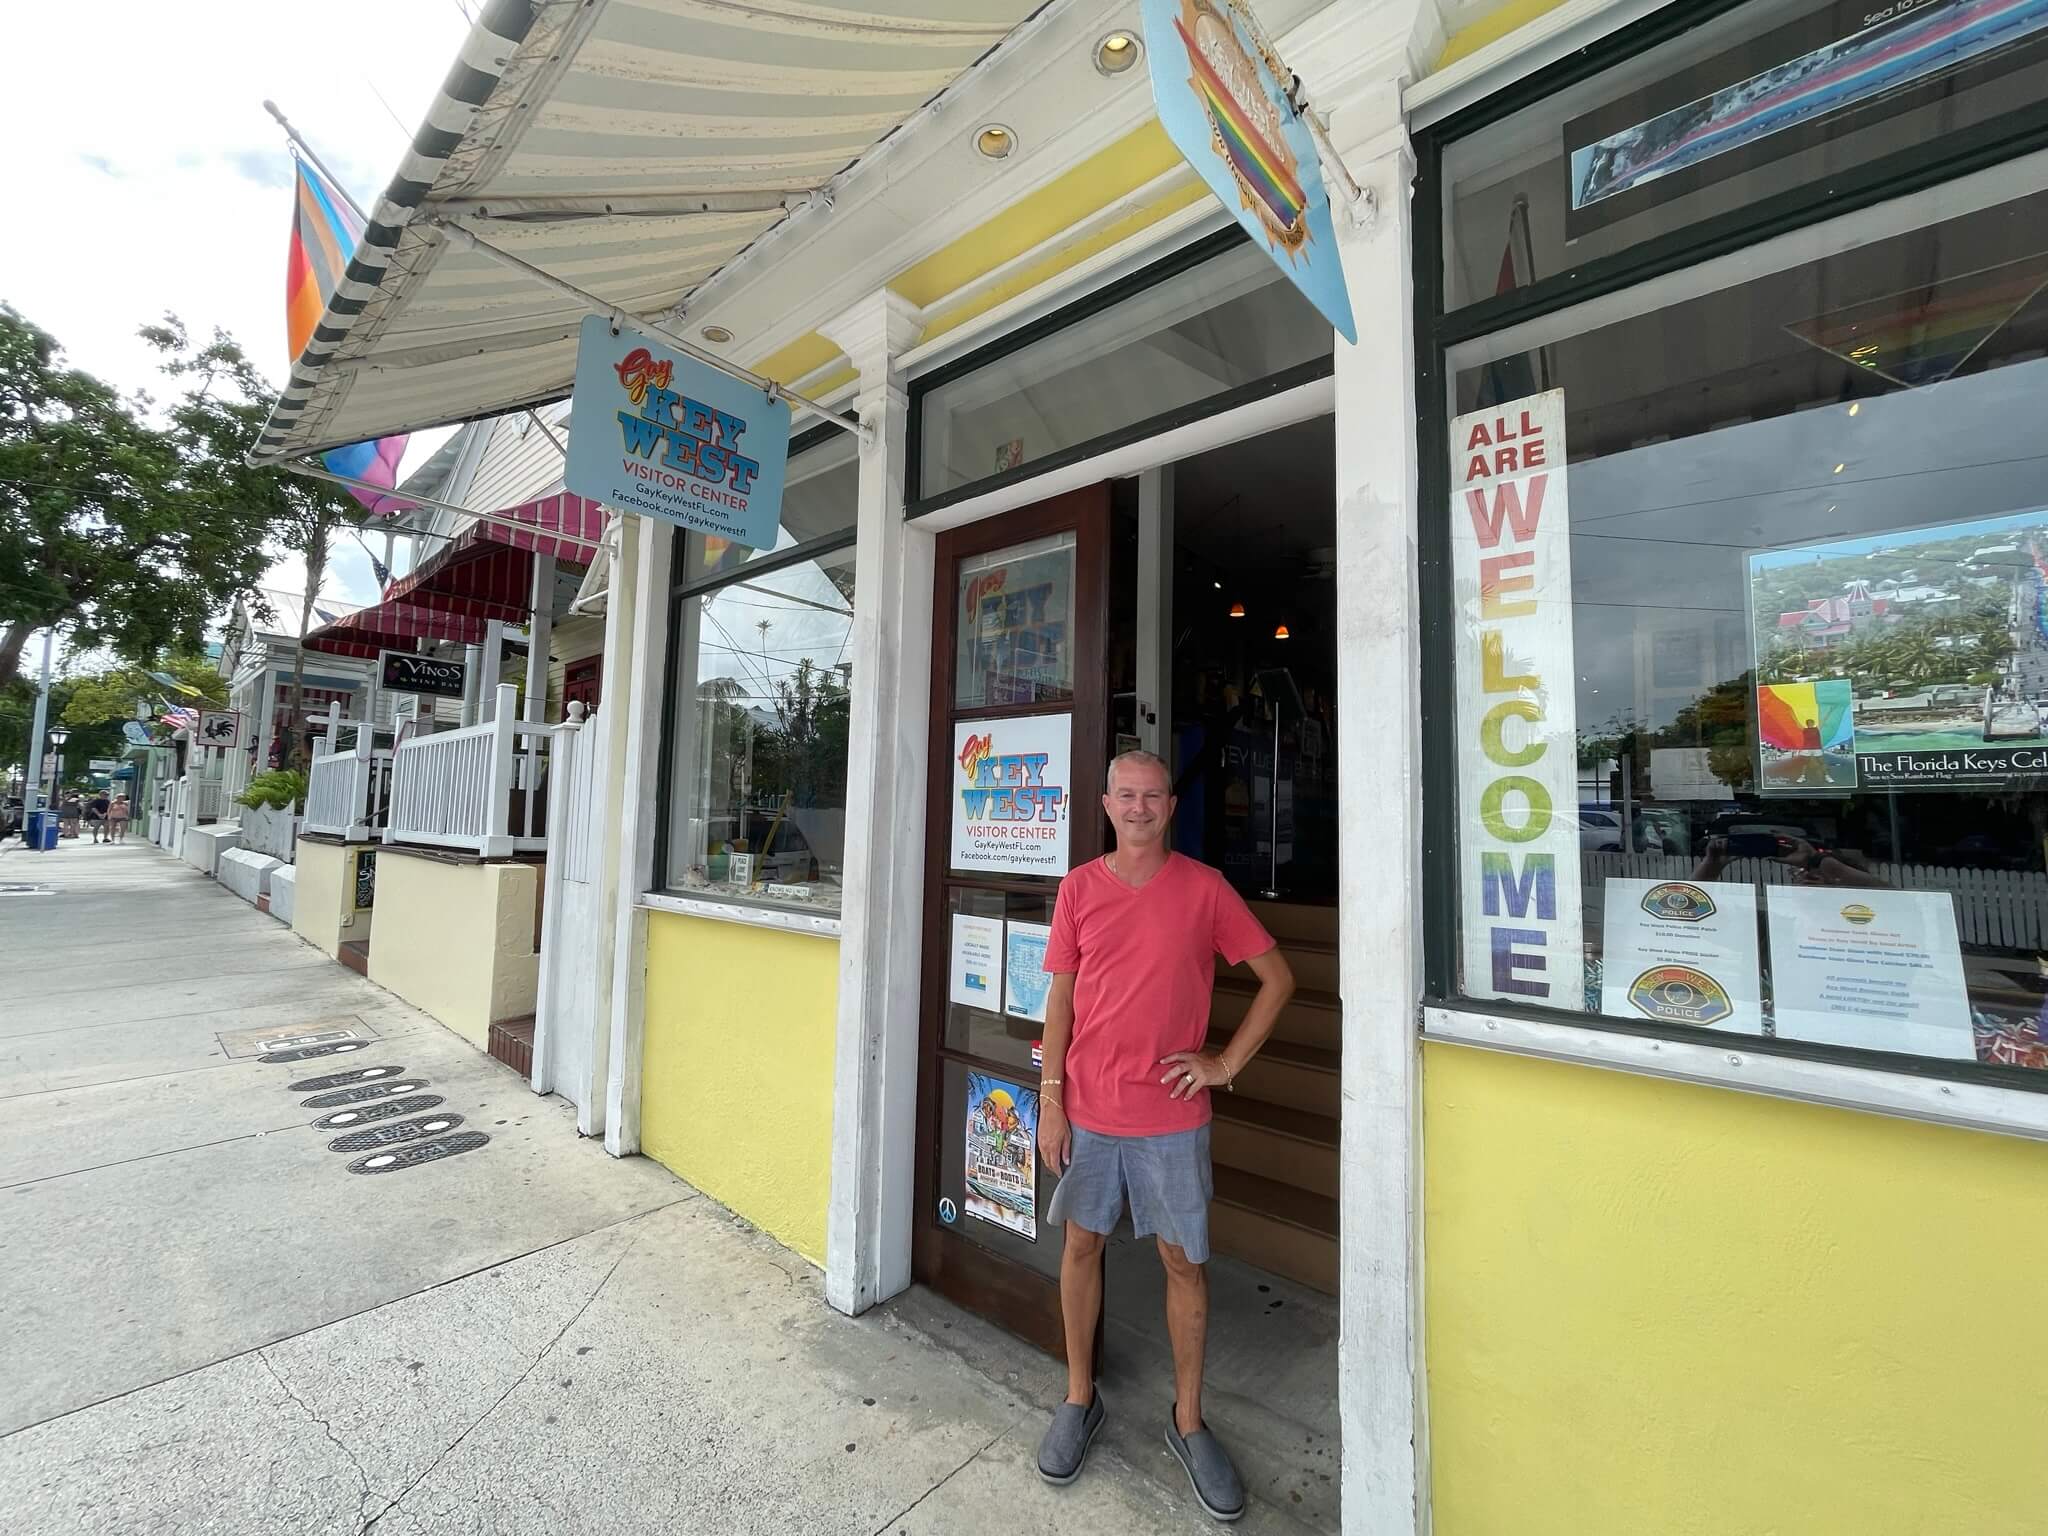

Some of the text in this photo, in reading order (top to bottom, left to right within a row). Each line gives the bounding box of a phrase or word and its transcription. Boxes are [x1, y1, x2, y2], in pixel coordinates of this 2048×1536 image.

[1863, 7, 1894, 26] Sea
[613, 347, 673, 405] Gay
[640, 384, 747, 454] KEY
[1466, 410, 1543, 450] ALL
[617, 411, 760, 496] WEST
[1466, 438, 1546, 482] ARE
[622, 459, 748, 512] VISITOR CENTER
[635, 482, 730, 520] GayKeyWestFL.com
[612, 489, 747, 537] Facebook.com/gaykeywestfl
[1465, 473, 1557, 998] WELCOME
[957, 733, 993, 779] Gay
[975, 752, 1049, 788] KEY
[1858, 756, 1893, 772] The
[1897, 754, 1960, 771] Florida
[1963, 752, 2008, 772] Keys
[966, 825, 1057, 840] VISITOR CENTER
[974, 840, 1042, 851] GayKeyWestFL.com
[960, 851, 1057, 864] Facebook.com/gaykeywestfl
[1662, 909, 1695, 917] POLICE
[1656, 1006, 1702, 1018] POLICE
